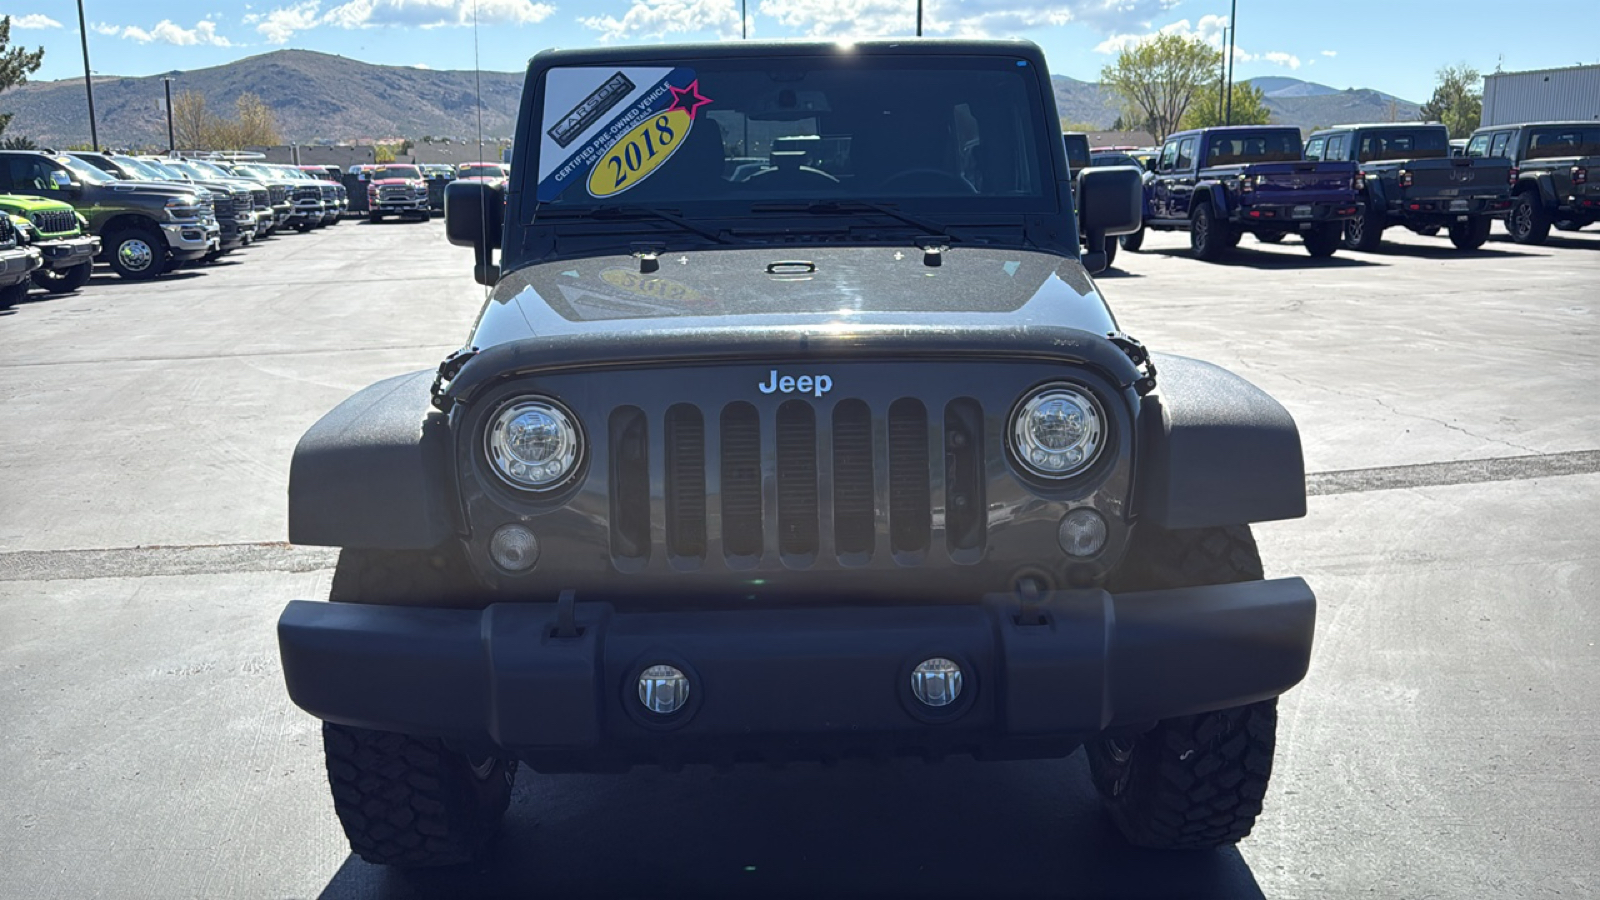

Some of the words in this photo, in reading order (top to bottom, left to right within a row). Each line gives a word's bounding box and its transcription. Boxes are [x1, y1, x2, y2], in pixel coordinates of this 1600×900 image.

[554, 145, 595, 182] CERTIFIED
[593, 108, 640, 149] PRE-OWNED
[637, 81, 671, 111] VEHICLE
[607, 115, 675, 189] 2018
[585, 153, 598, 166] ASK
[758, 369, 833, 397] Jeep
